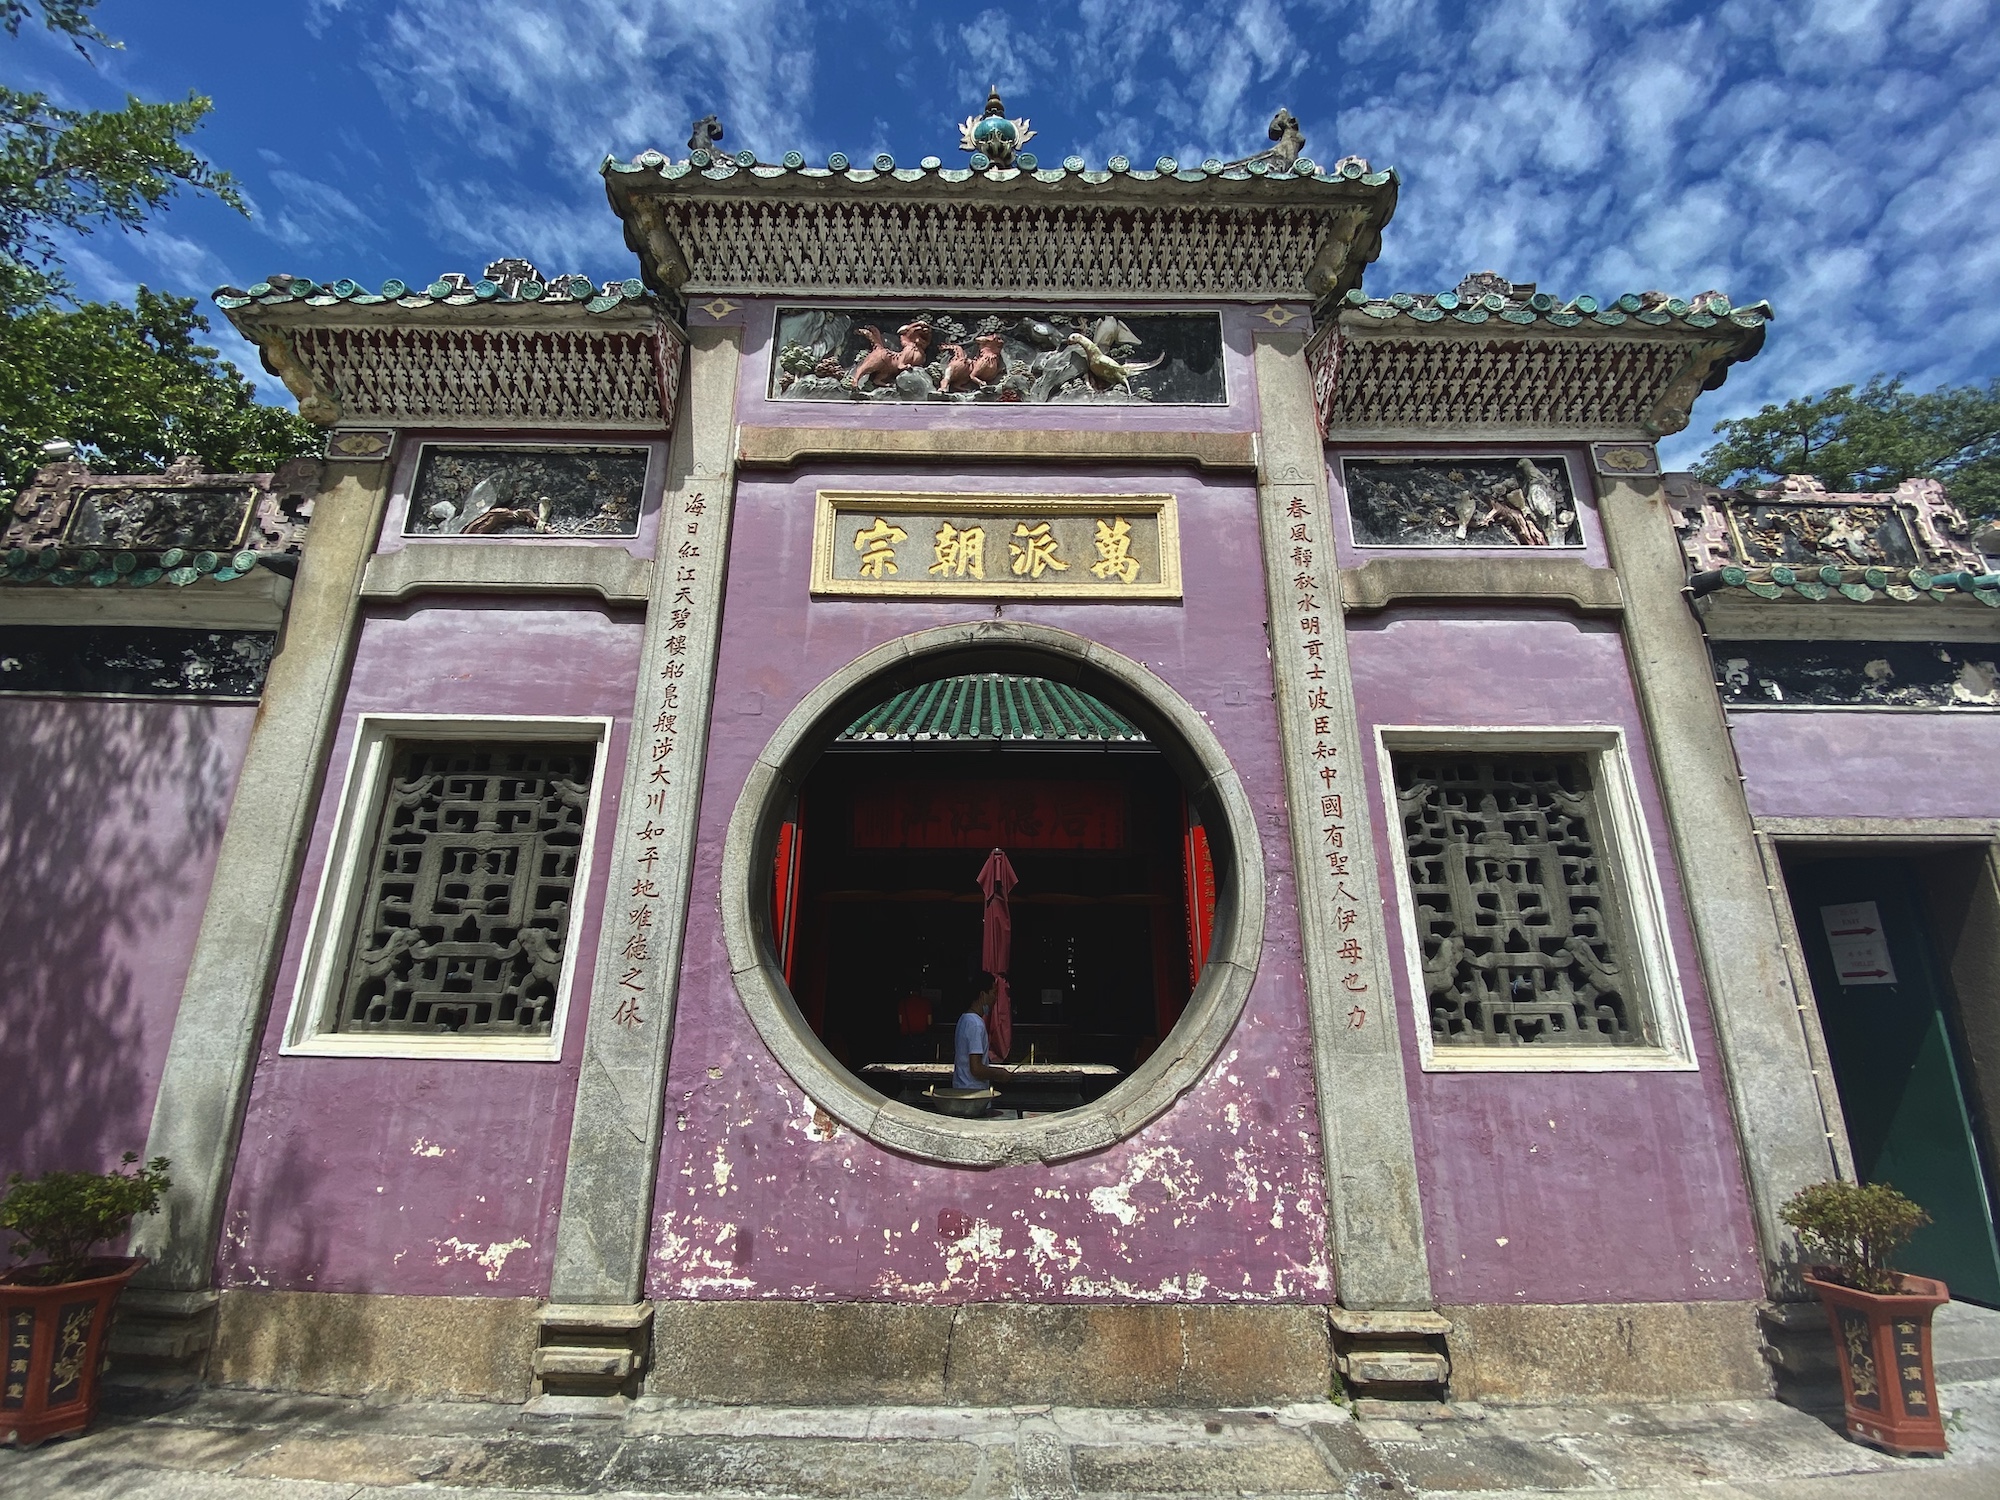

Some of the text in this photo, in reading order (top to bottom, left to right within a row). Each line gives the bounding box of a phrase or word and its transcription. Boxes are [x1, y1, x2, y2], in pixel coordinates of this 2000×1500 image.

[854, 516, 1141, 583] 萬派朝宗
[6, 1312, 33, 1399] 金玉滿堂
[1897, 1321, 1928, 1405] 金玉滿堂
